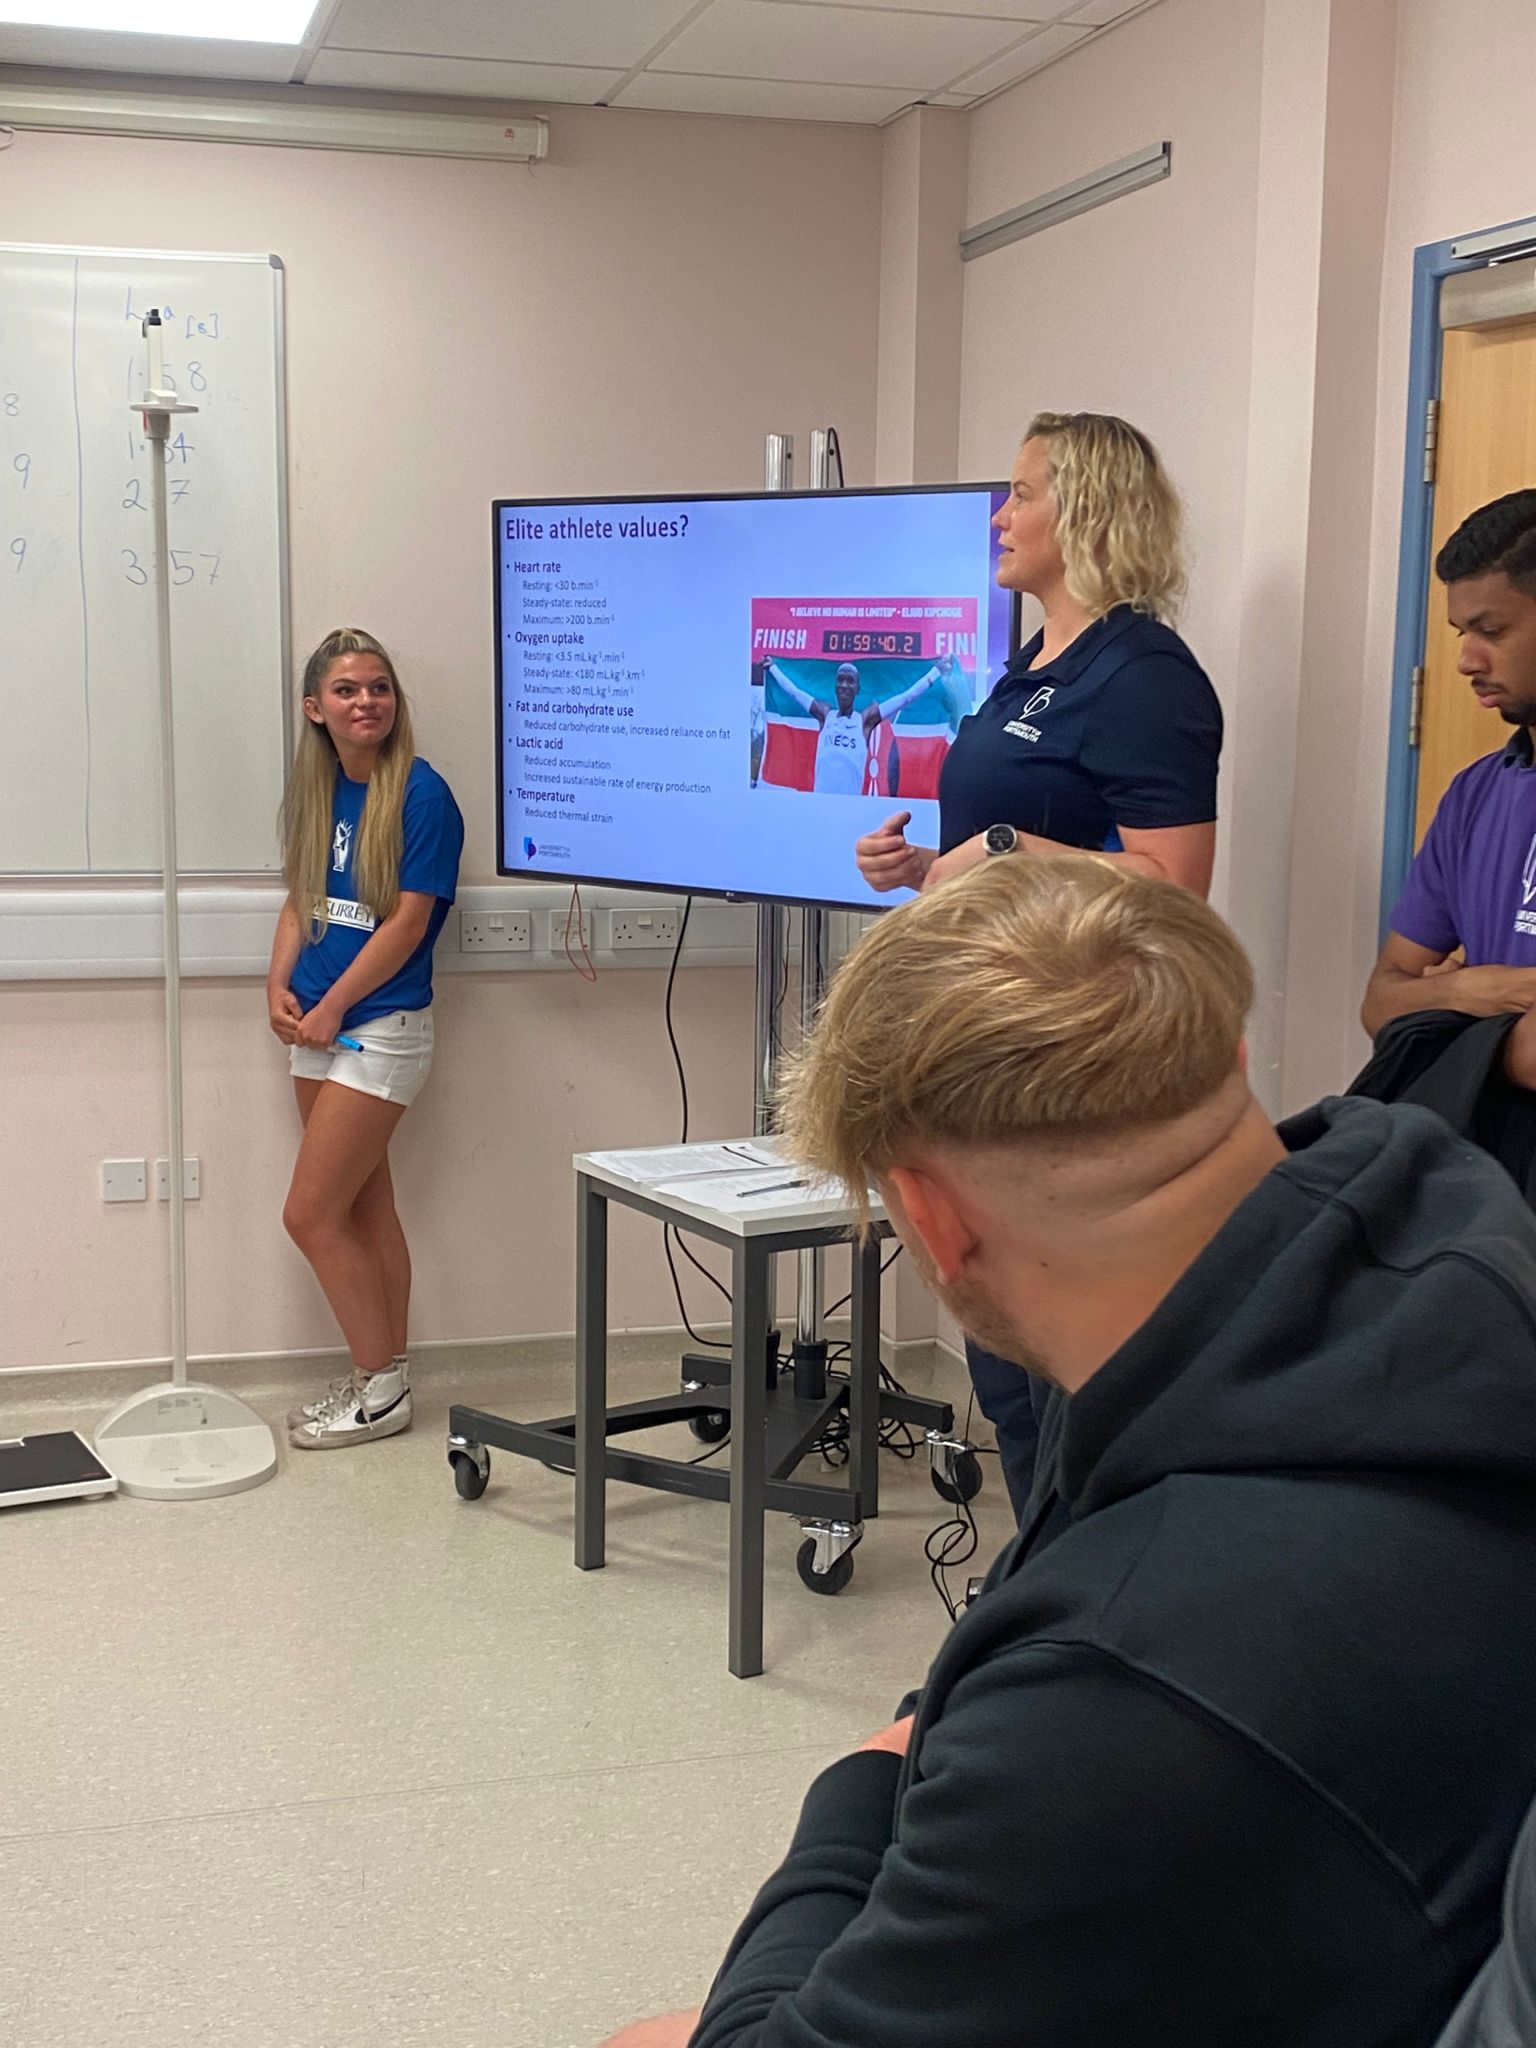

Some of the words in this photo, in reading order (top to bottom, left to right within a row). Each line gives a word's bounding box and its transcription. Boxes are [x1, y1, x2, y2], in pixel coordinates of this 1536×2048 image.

[505, 518, 543, 540] Elite
[550, 516, 613, 540] athlete
[619, 514, 689, 538] values?
[513, 561, 540, 574] Heart
[542, 562, 562, 574] rate
[522, 580, 552, 593] Resting:
[574, 597, 607, 609] reduced
[522, 614, 563, 625] Maximum:
[565, 614, 586, 626] >200
[515, 631, 550, 646] Oxygen
[552, 632, 584, 647] uptake
[754, 628, 808, 650] FINISH
[523, 651, 553, 663] Resting:
[515, 701, 530, 712] Fat
[532, 701, 549, 713] and
[551, 702, 614, 718] carbohydrate
[617, 707, 634, 717] use
[524, 720, 557, 731] Reduced
[558, 721, 610, 735] carbohydrate
[630, 724, 669, 737] increased
[671, 726, 704, 738] reliance
[705, 729, 717, 739] on
[719, 729, 731, 740] fat
[516, 736, 542, 749] Lactic
[544, 738, 563, 750] acid
[524, 755, 557, 767] Reduced
[559, 757, 612, 770] accumulation
[524, 772, 561, 785] Increased
[562, 774, 607, 787] sustainable
[608, 778, 624, 788] rate
[625, 777, 635, 789] of
[636, 781, 664, 793] energy
[665, 782, 711, 794] production
[517, 787, 575, 803] Temperature
[524, 807, 557, 819] Reduced
[559, 809, 590, 822] thermal
[591, 812, 613, 824] strain
